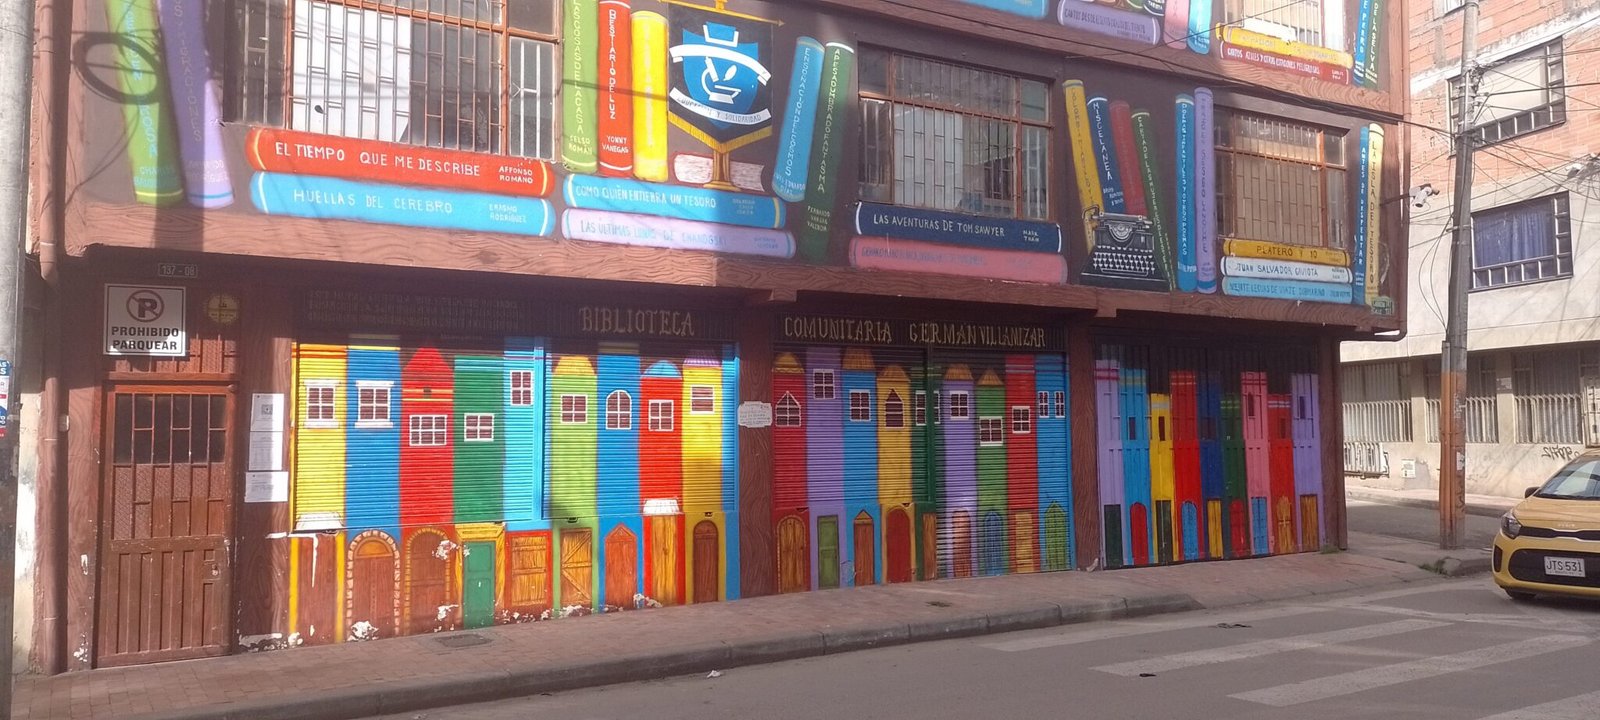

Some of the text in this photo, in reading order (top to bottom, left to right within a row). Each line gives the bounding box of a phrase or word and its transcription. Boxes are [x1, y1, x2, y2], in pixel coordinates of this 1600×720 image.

[608, 9, 616, 76] BESTIARIO
[602, 142, 628, 154] VANEGAS
[275, 142, 480, 176] EL TIEMPO QUE ME DESCRIBE
[498, 166, 533, 176] AFFONSO
[499, 174, 534, 184] ROMANO
[294, 189, 453, 214] HUELLAS DEL CEREBRO
[575, 186, 600, 198] COMO
[670, 194, 682, 204] UN
[683, 194, 717, 208] TESORO
[873, 214, 1006, 238] LAS AVENTURAS DE TOM SAWYER
[1256, 246, 1294, 257] PLATERO
[161, 266, 176, 276] 137
[1237, 263, 1254, 272] JUAN
[1257, 264, 1293, 275] SALVADOR
[579, 306, 695, 336] BIBLIOTECA
[111, 326, 179, 338] PROHIBIDO
[784, 317, 892, 344] COMUNITARIA
[978, 325, 1046, 348] VILLAMIZAR
[112, 340, 178, 350] PARQUEAR
[1546, 560, 1583, 572] JTS 531
